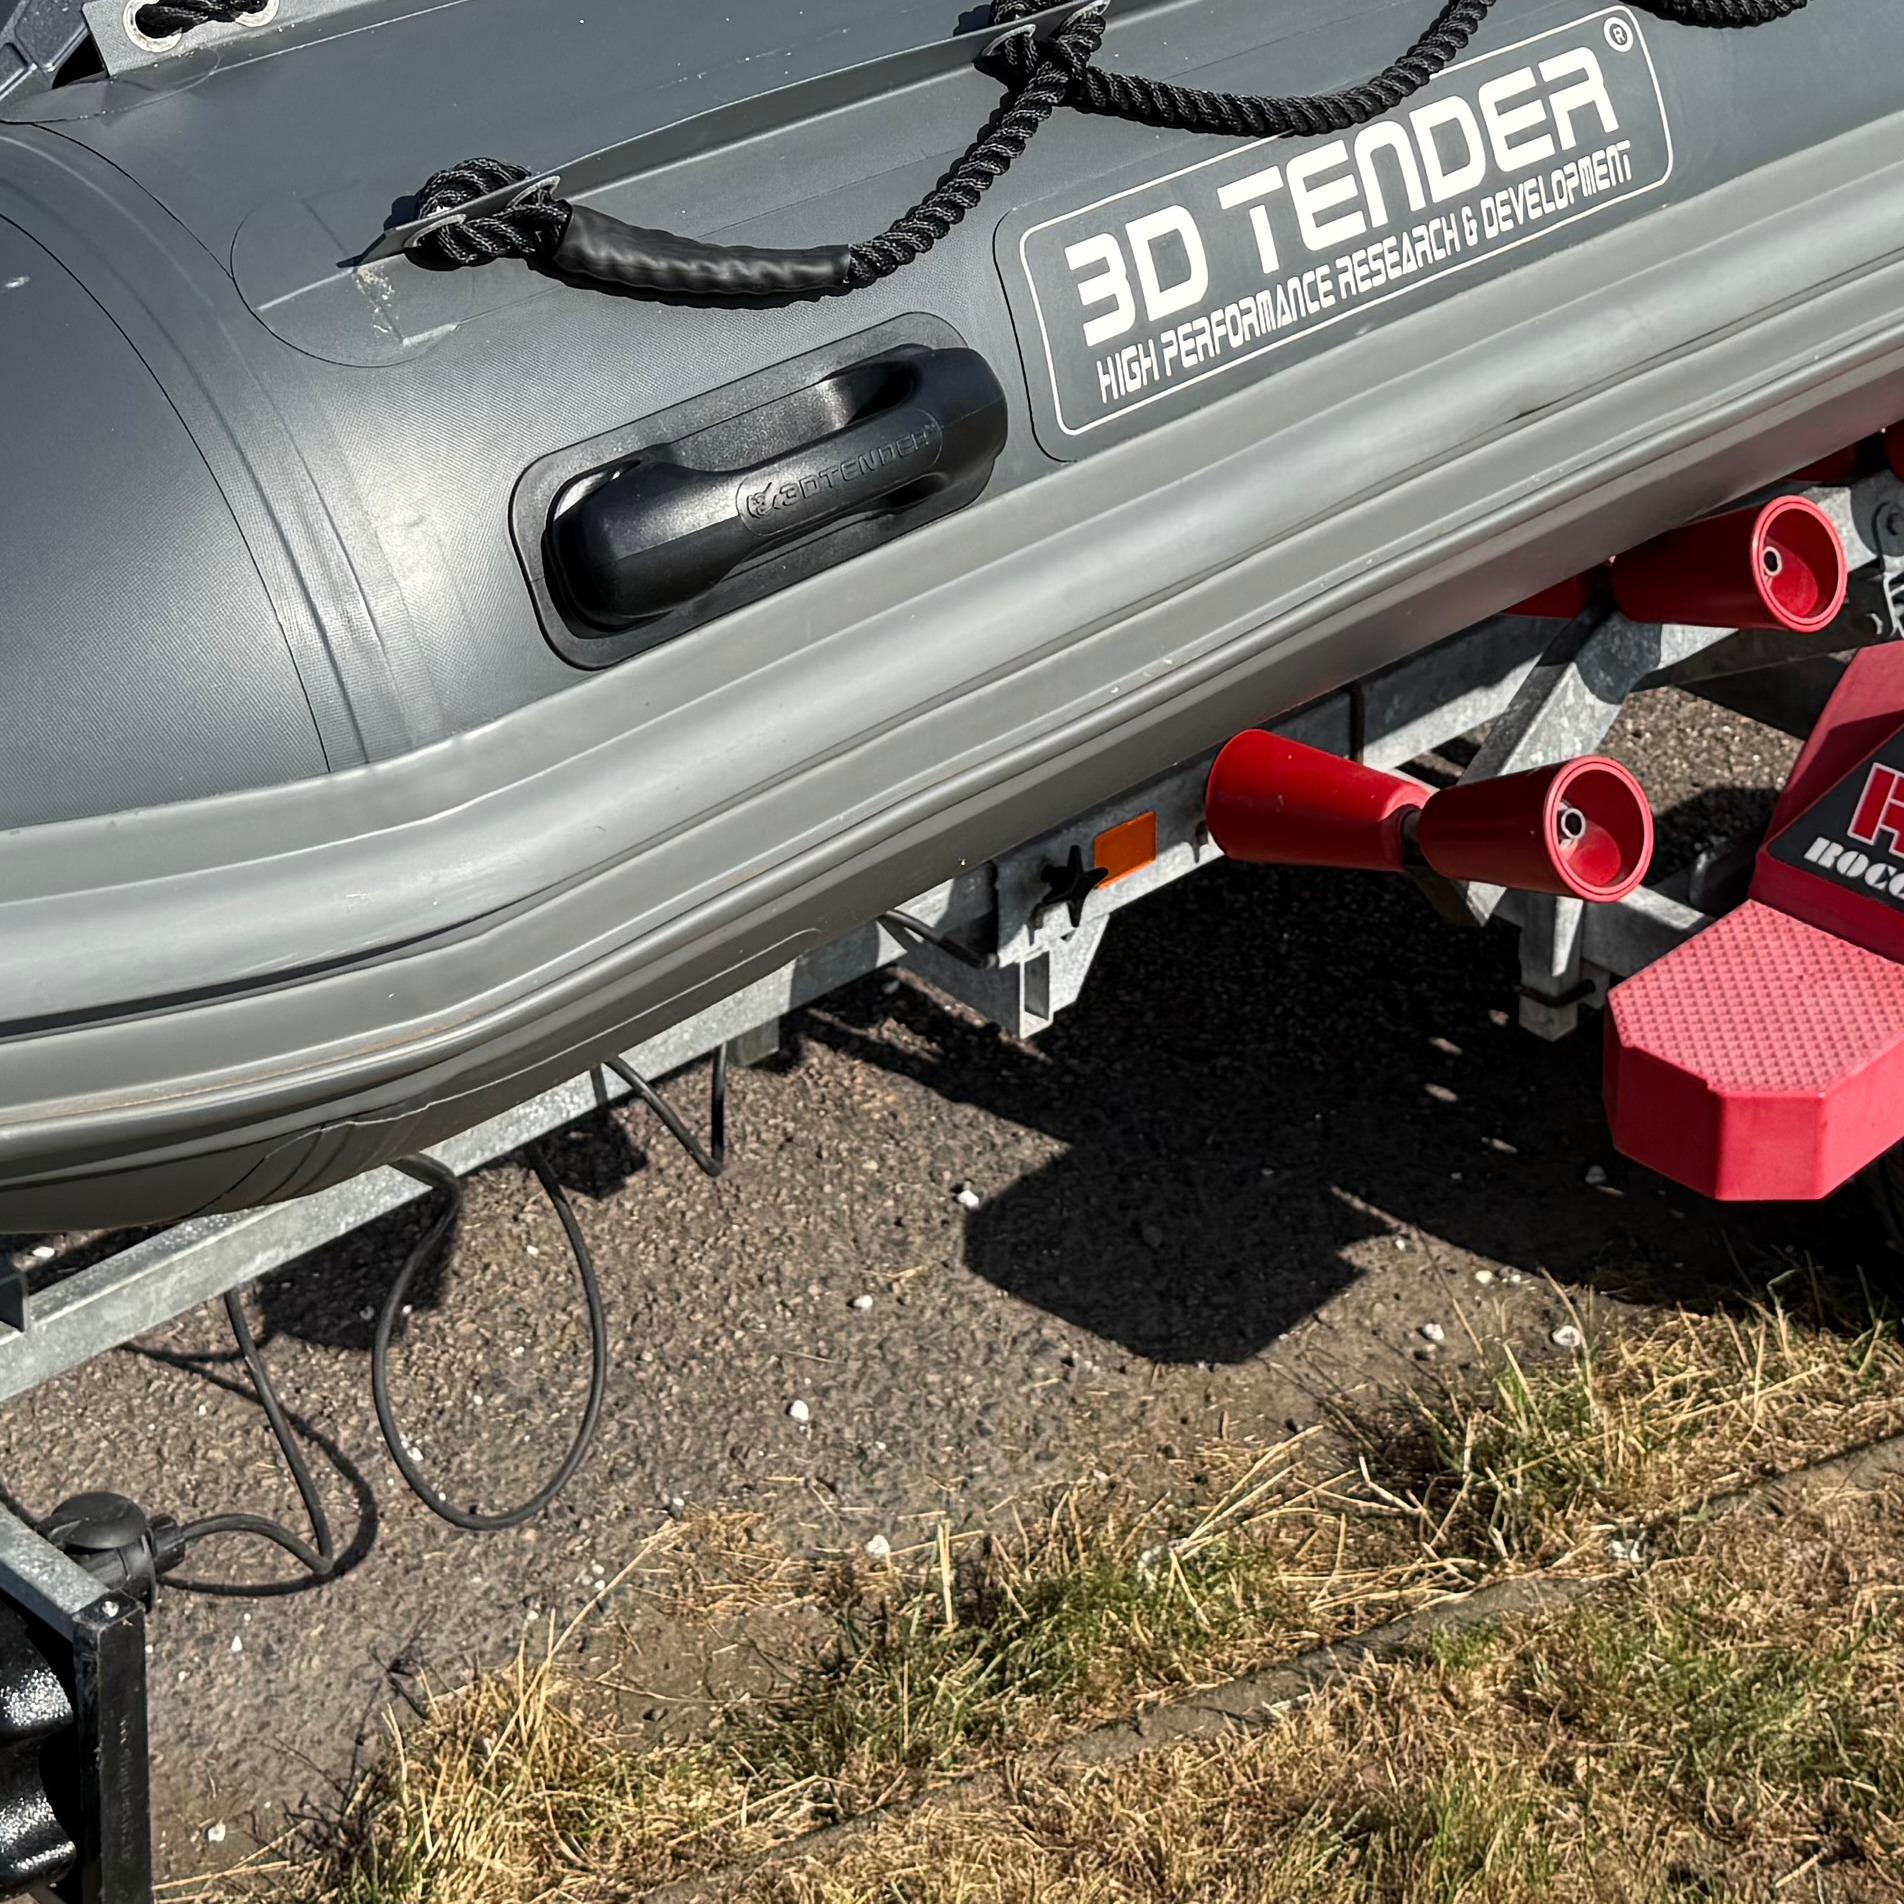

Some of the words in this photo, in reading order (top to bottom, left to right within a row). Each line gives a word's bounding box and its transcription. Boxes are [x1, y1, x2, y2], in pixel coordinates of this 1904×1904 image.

[1064, 204, 1210, 347] 3D
[1216, 46, 1620, 275] TENDER
[1096, 338, 1160, 404] HIGH
[1159, 263, 1337, 377] PERFORMANCE
[1335, 211, 1462, 300] RESEARCH
[1460, 205, 1479, 247] &
[1479, 139, 1633, 240] DEVELOPMENT
